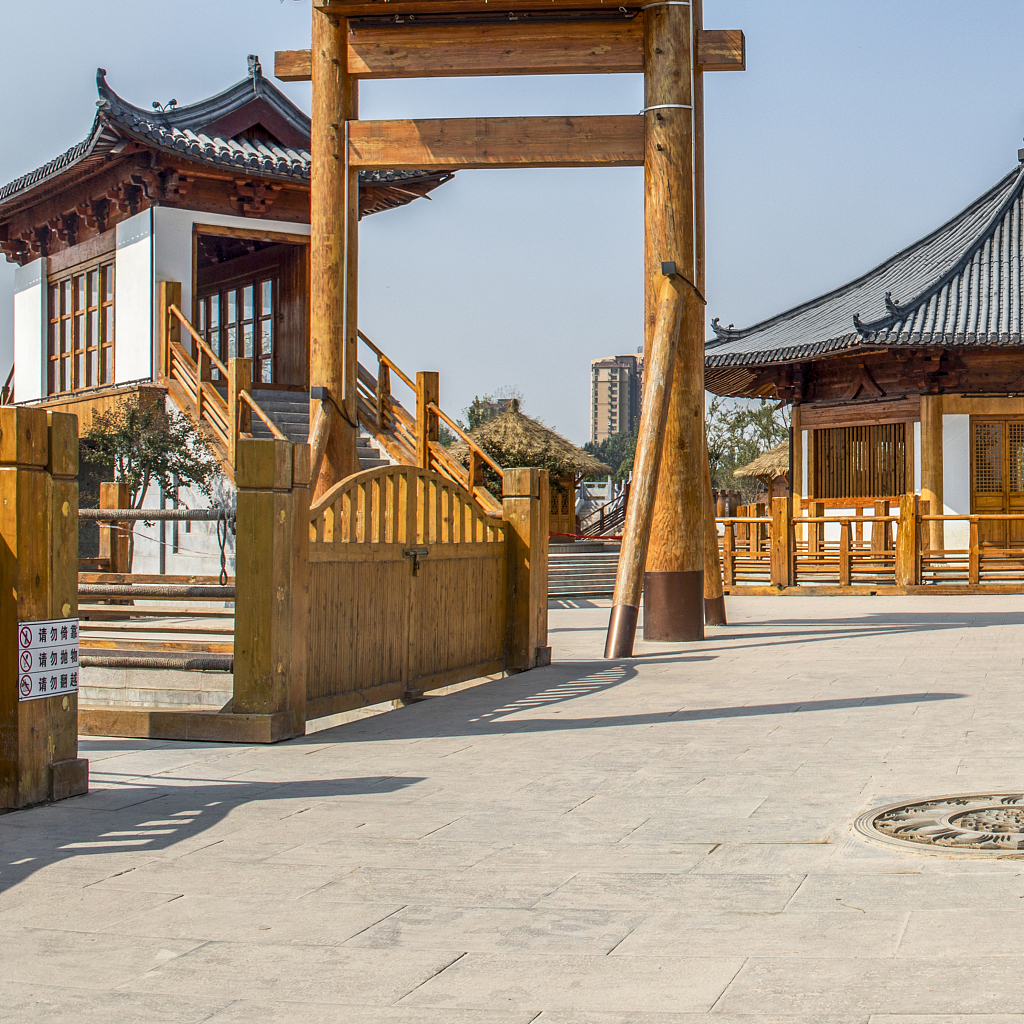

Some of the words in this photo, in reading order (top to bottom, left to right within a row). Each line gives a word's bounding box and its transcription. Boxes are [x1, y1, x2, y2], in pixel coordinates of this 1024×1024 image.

[38, 624, 78, 643] 请勿倚靠
[38, 648, 78, 668] 请勿抛物
[38, 672, 78, 692] 请勿翻越
